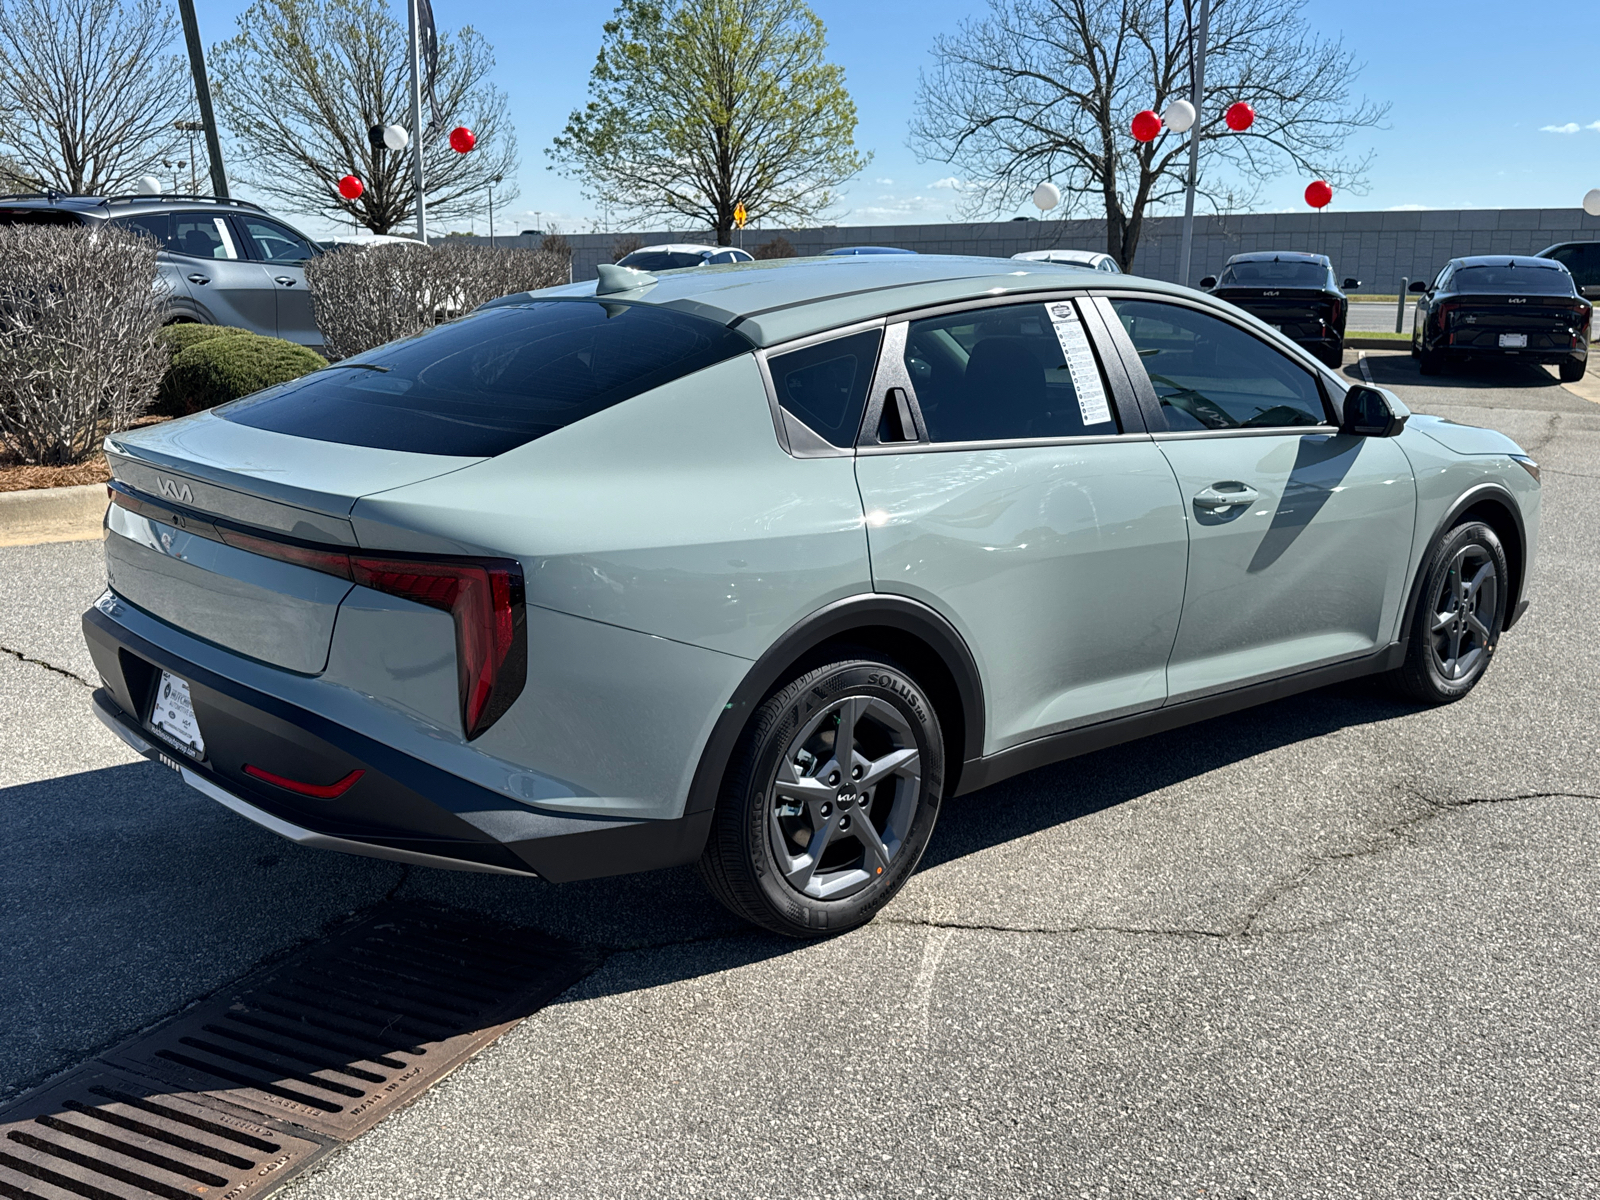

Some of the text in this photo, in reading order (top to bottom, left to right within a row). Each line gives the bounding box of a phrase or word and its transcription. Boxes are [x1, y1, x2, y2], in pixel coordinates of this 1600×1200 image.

[157, 475, 194, 503] KIA
[867, 673, 919, 707] SOLUS
[837, 793, 857, 802] KIA
[751, 791, 765, 879] KUMHO
